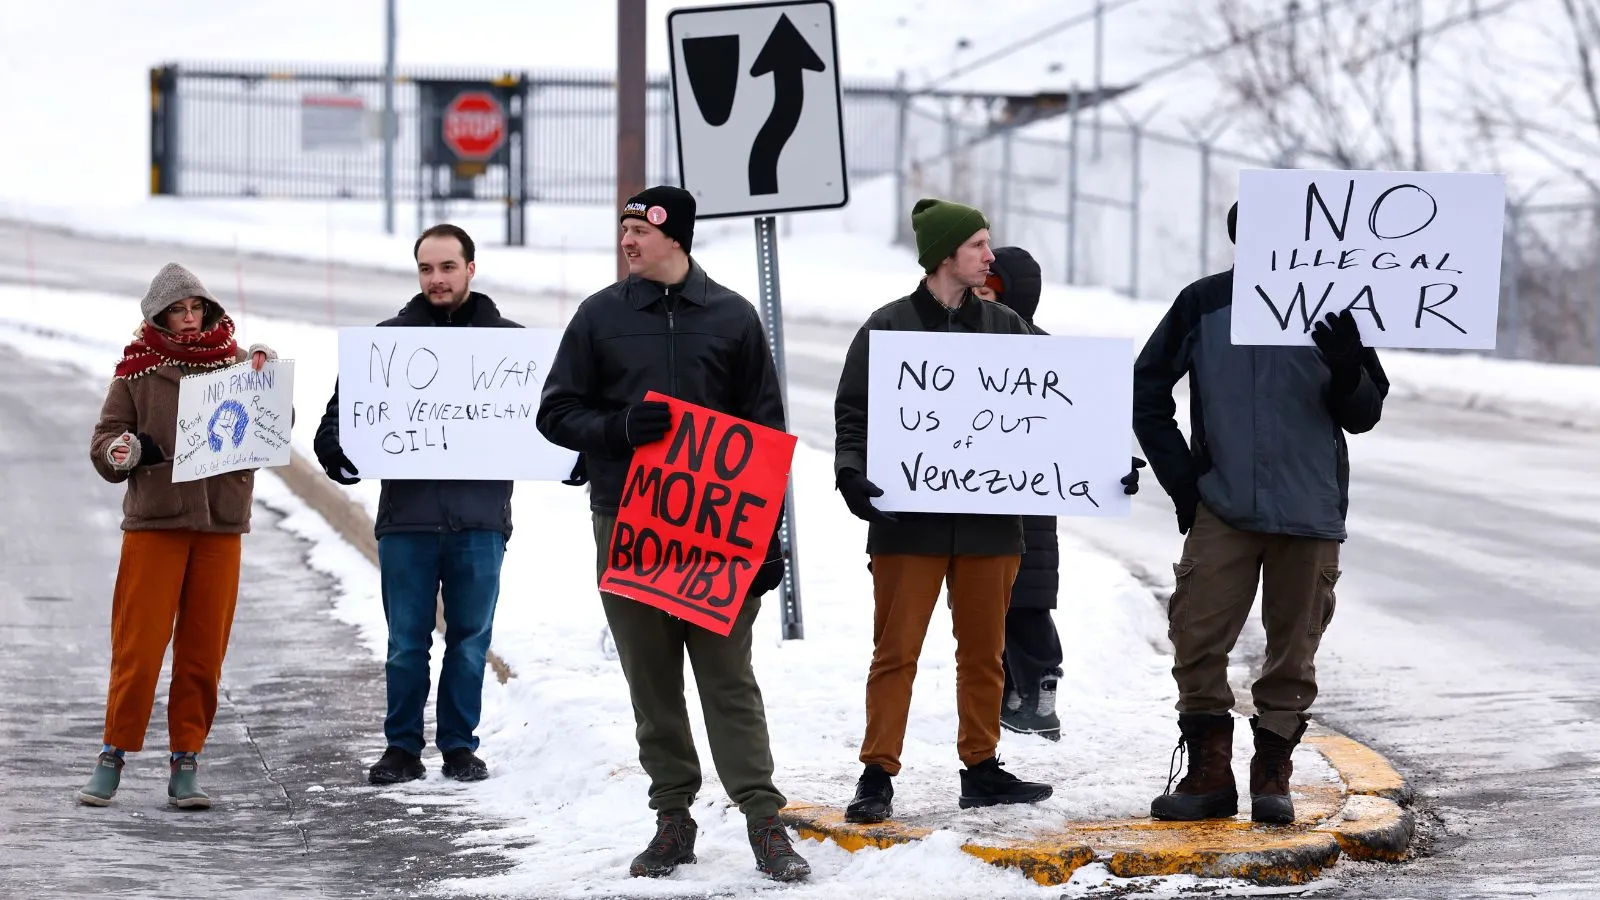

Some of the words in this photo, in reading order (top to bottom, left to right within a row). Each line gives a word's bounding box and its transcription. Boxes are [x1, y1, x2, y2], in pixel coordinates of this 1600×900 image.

[451, 111, 501, 139] STOP
[1305, 179, 1438, 241] NO
[1271, 248, 1463, 274] ILLEGAL
[1254, 281, 1468, 335] WAR
[369, 341, 439, 390] NO
[471, 354, 540, 391] WAR
[898, 360, 955, 391] NO
[978, 367, 1073, 406] WAR
[178, 412, 203, 433] Resist
[250, 395, 280, 421] Reject
[353, 401, 391, 428] FOR
[406, 399, 532, 422] VENEZUELAN
[900, 407, 940, 432] US
[972, 409, 1047, 434] OUT
[187, 432, 201, 447] US
[382, 425, 448, 454] OIL!
[664, 411, 754, 481] NO
[953, 436, 973, 449] of
[195, 462, 207, 476] US
[222, 453, 232, 465] of
[901, 452, 1100, 508] Venezuela
[621, 464, 768, 550] MORE
[611, 521, 753, 608] BOMBS
